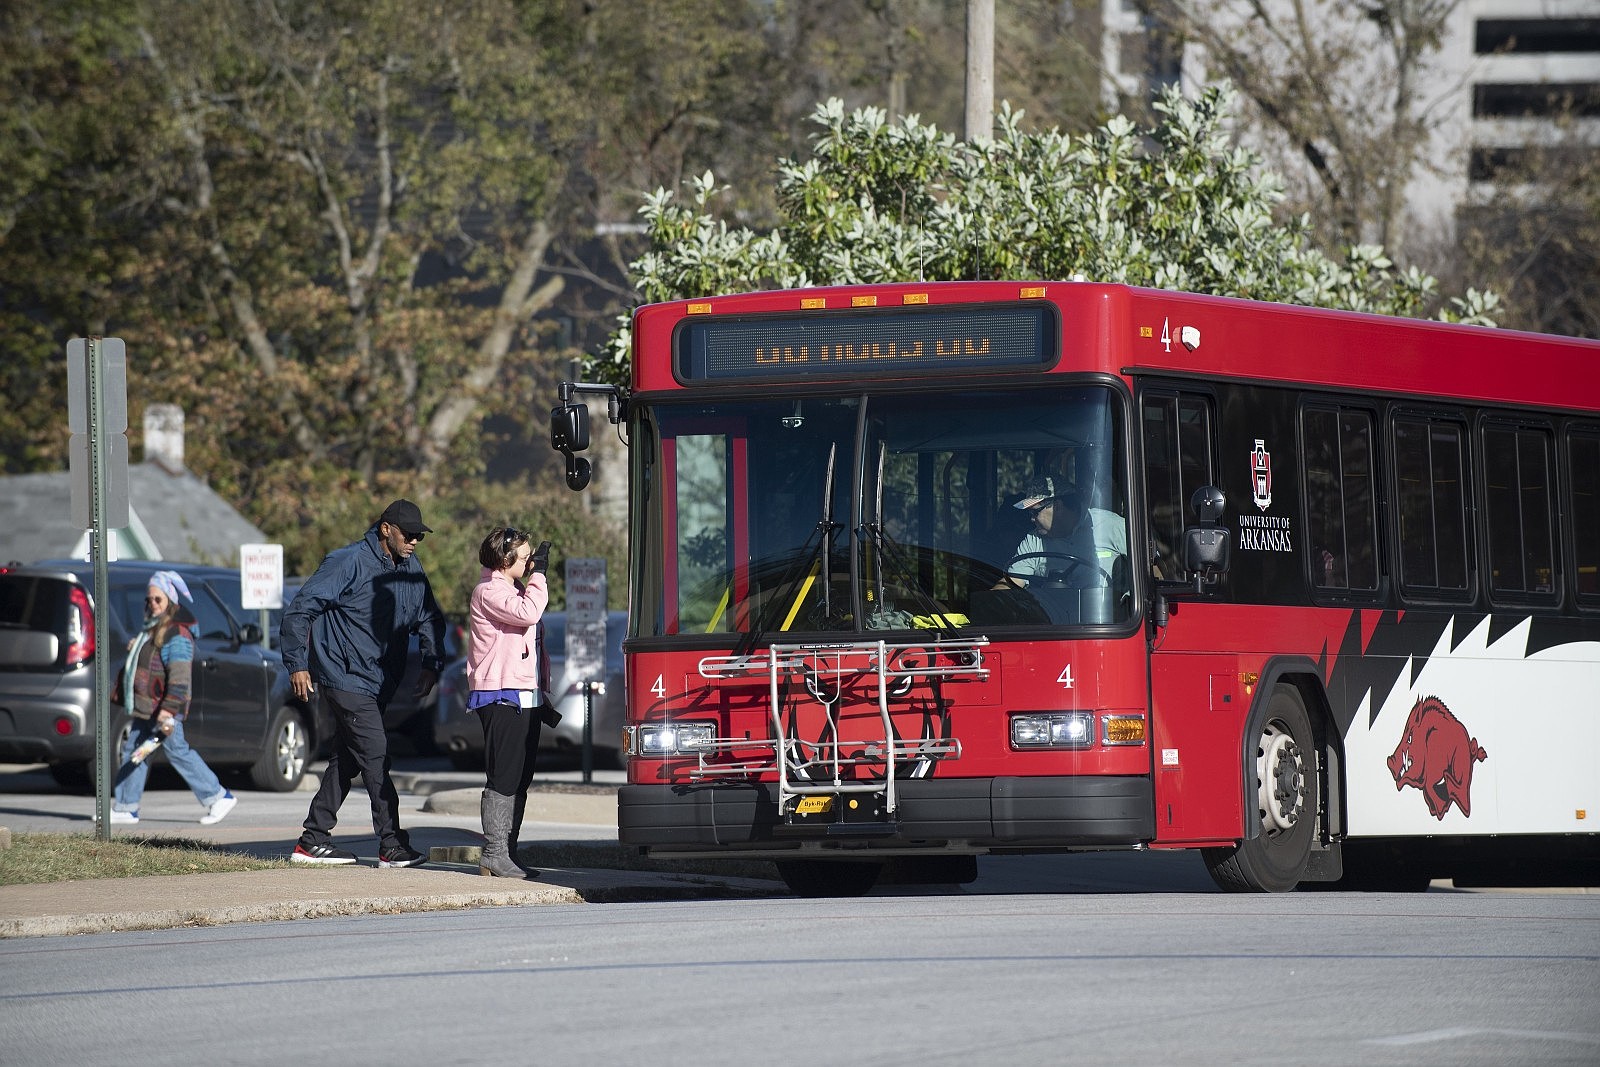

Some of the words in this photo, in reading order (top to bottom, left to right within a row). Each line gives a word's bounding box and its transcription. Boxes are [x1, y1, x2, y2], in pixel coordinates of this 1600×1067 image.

[1160, 316, 1172, 353] 4
[1239, 515, 1280, 528] UNIVERSITY
[1281, 517, 1290, 529] OF
[1239, 528, 1292, 552] ARKANSAS
[650, 673, 666, 699] 4
[1056, 663, 1075, 689] 4
